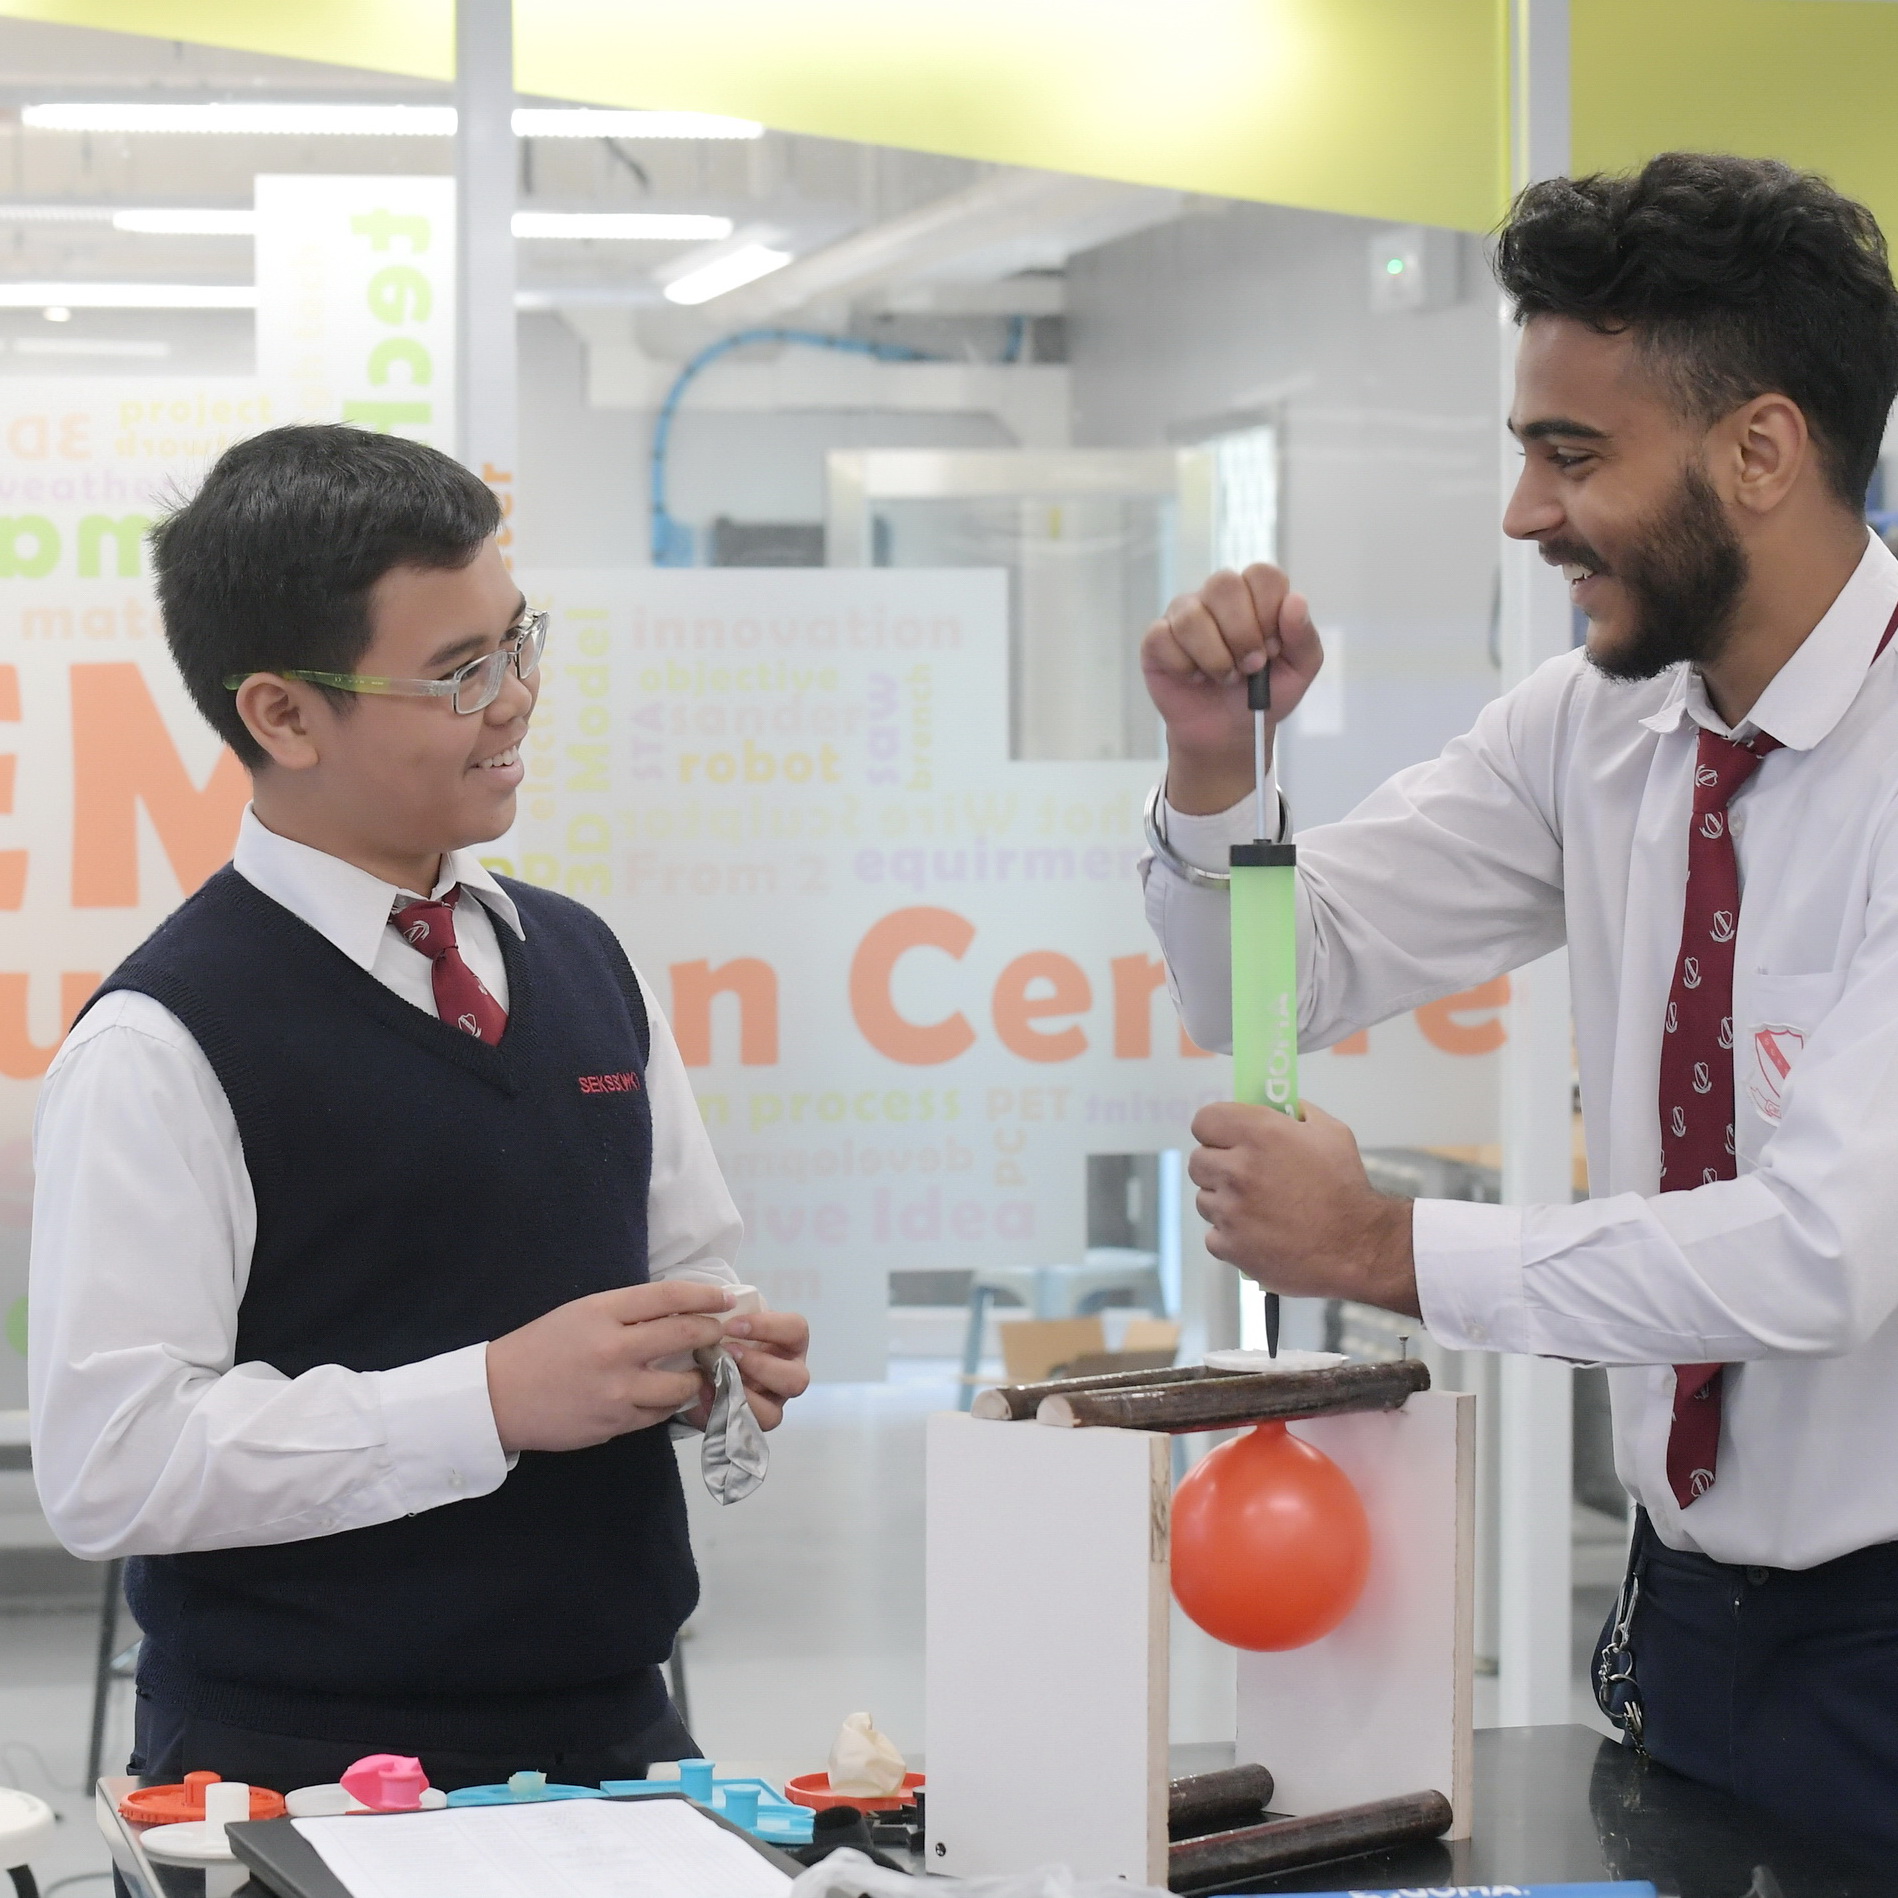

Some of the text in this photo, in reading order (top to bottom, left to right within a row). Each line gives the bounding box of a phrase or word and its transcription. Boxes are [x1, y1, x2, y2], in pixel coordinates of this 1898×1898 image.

[118, 392, 274, 429] project
[632, 606, 964, 650] innovation
[564, 607, 610, 792] Model
[640, 656, 840, 697] objective
[672, 690, 865, 736] sander
[866, 672, 899, 787] saw
[678, 738, 843, 784] robot
[0, 660, 253, 909] M
[748, 1086, 962, 1133] process
[986, 1084, 1072, 1122] PET
[873, 1186, 1036, 1246] Idea
